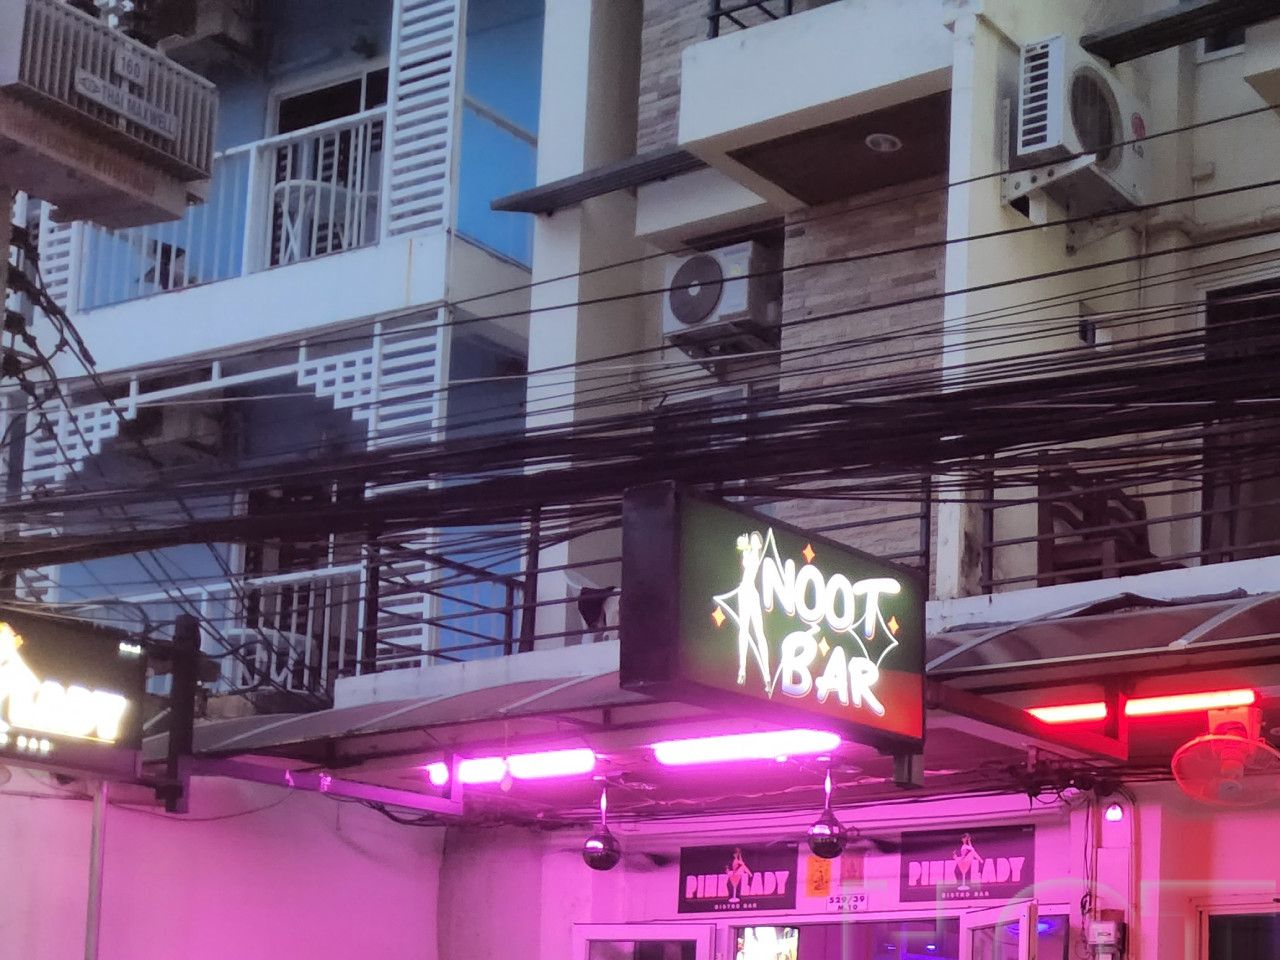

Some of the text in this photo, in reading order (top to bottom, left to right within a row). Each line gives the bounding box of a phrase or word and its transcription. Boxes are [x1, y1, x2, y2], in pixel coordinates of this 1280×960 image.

[120, 56, 140, 79] 160
[761, 556, 901, 640] NOOT
[781, 630, 885, 716] BAR
[685, 870, 790, 899] PINK LADY
[908, 856, 1026, 886] PINK LADY
[829, 896, 865, 905] 529/39
